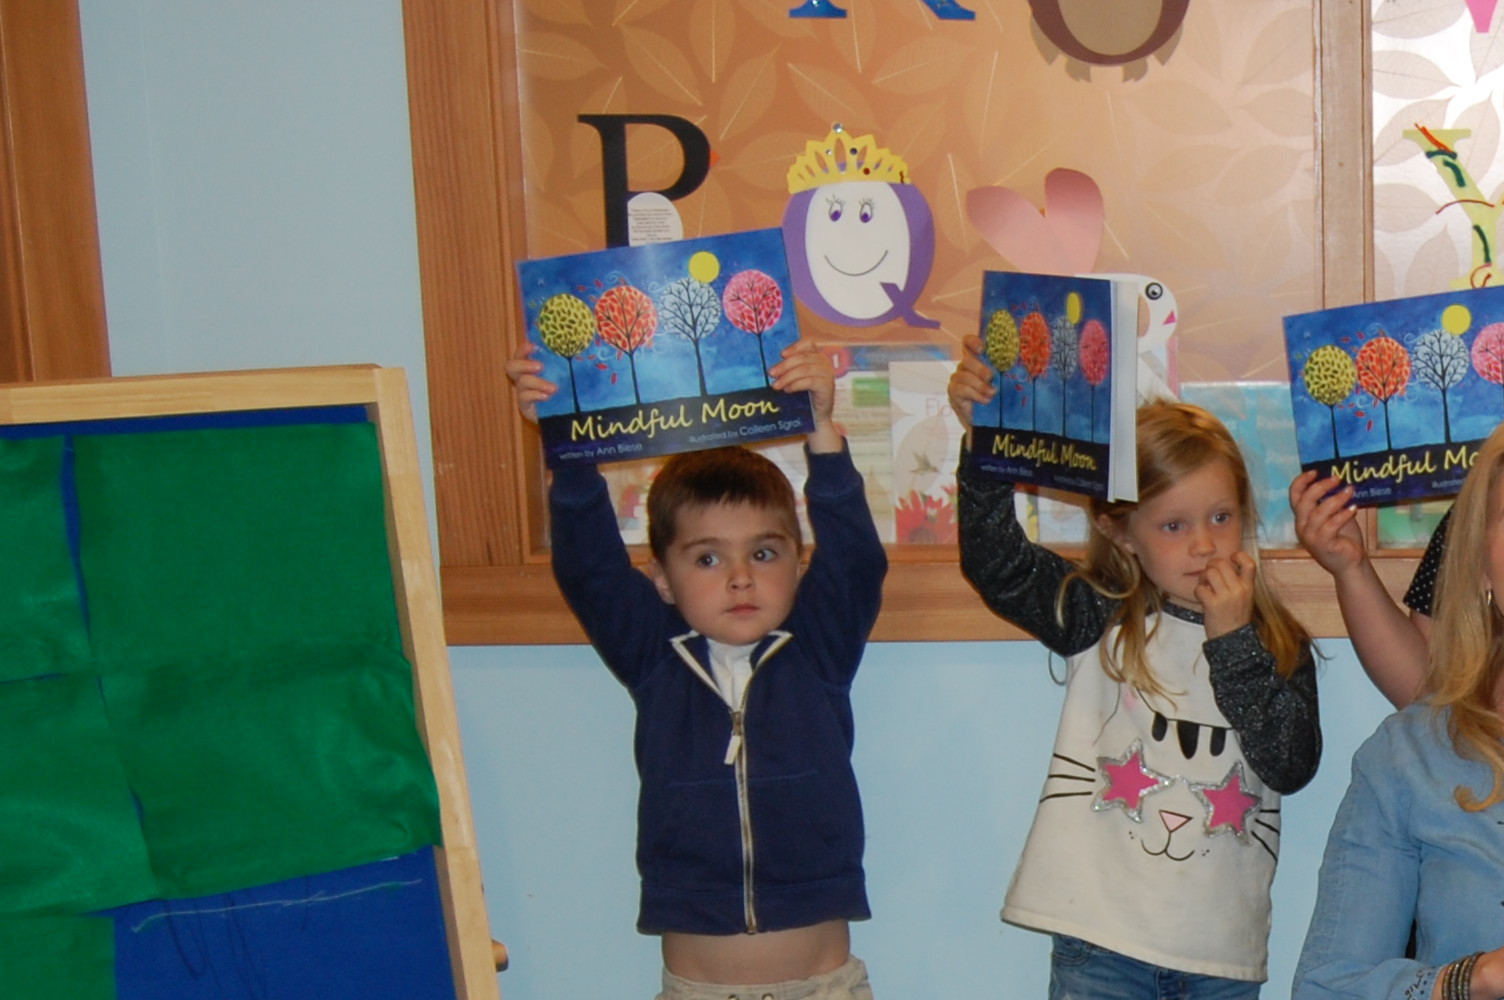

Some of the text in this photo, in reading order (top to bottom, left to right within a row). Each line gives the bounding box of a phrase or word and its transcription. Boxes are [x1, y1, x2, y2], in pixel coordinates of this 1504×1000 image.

[571, 397, 780, 442] Mindful Moon
[739, 421, 777, 437] Colleen
[596, 445, 616, 456] Ann
[617, 442, 642, 454] Biese
[992, 433, 1097, 471] Mindful Moon
[1331, 445, 1479, 484] Mindful Mo
[1370, 486, 1392, 498] Biese
